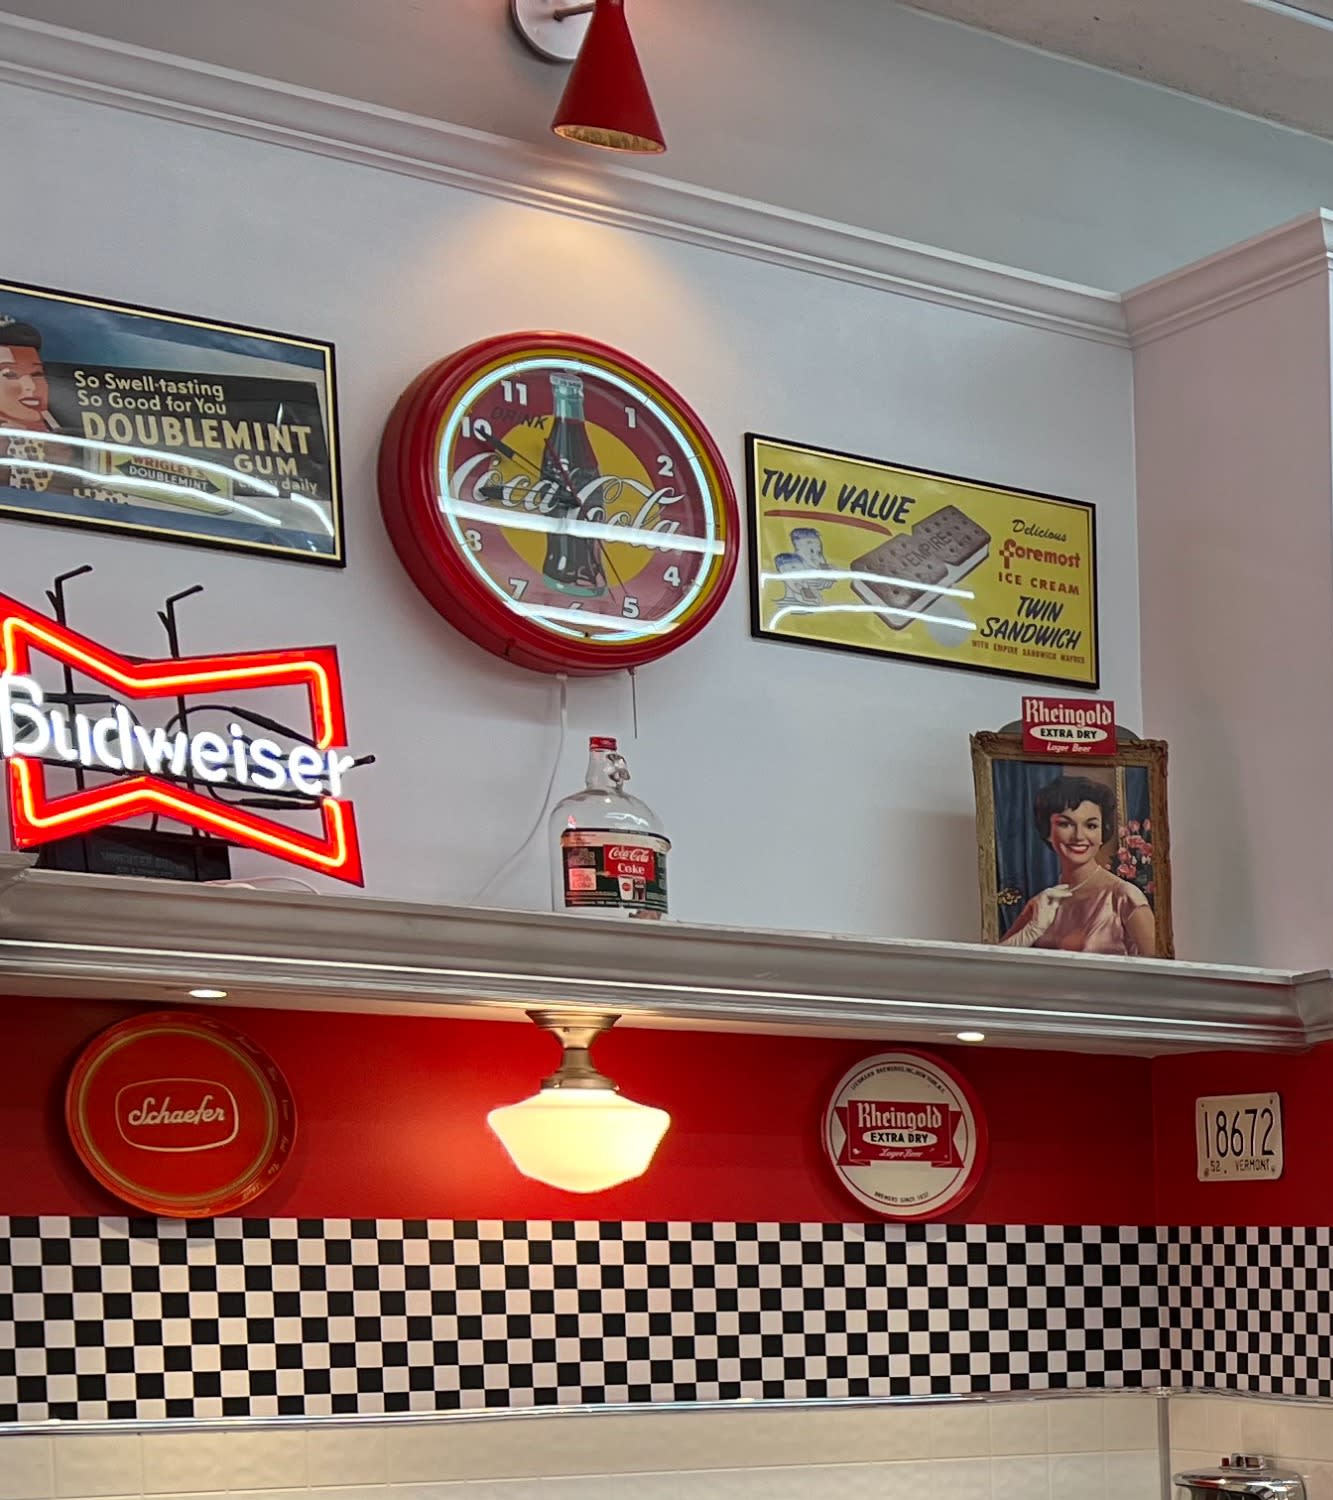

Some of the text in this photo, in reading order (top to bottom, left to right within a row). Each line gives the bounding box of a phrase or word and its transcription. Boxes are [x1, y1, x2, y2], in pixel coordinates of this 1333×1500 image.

[74, 370, 224, 400] So Swell-tasting
[500, 380, 528, 406] 11
[78, 390, 227, 415] So Good for You
[461, 416, 492, 441] 10
[490, 407, 549, 430] DRINK
[624, 406, 637, 428] 1
[81, 411, 311, 455] DOUBLEMINT
[233, 454, 298, 476] GUM
[656, 455, 674, 477] 2
[129, 465, 209, 490] DOUBLEMINT
[281, 477, 318, 496] daily
[761, 468, 916, 524] TWIN VALUE
[465, 529, 482, 551] 8
[1012, 519, 1067, 542] Delicious
[663, 566, 681, 586] 4
[998, 572, 1080, 596] ICE CREAM
[509, 578, 529, 600] 7
[622, 597, 639, 618] 5
[1017, 596, 1064, 622] TWIN
[980, 617, 1082, 650] SANDWICH
[1025, 699, 1112, 728] Rheingold
[0, 673, 356, 798] Budweiser
[1040, 728, 1097, 739] EXTRA DRY
[618, 863, 645, 874] Coke
[128, 1094, 226, 1126] Schaefer
[857, 1102, 943, 1131] Rheingold
[870, 1132, 929, 1144] EXTRA DRY
[1205, 1107, 1275, 1159] 18672
[1210, 1158, 1270, 1172] 52 VERMONT
